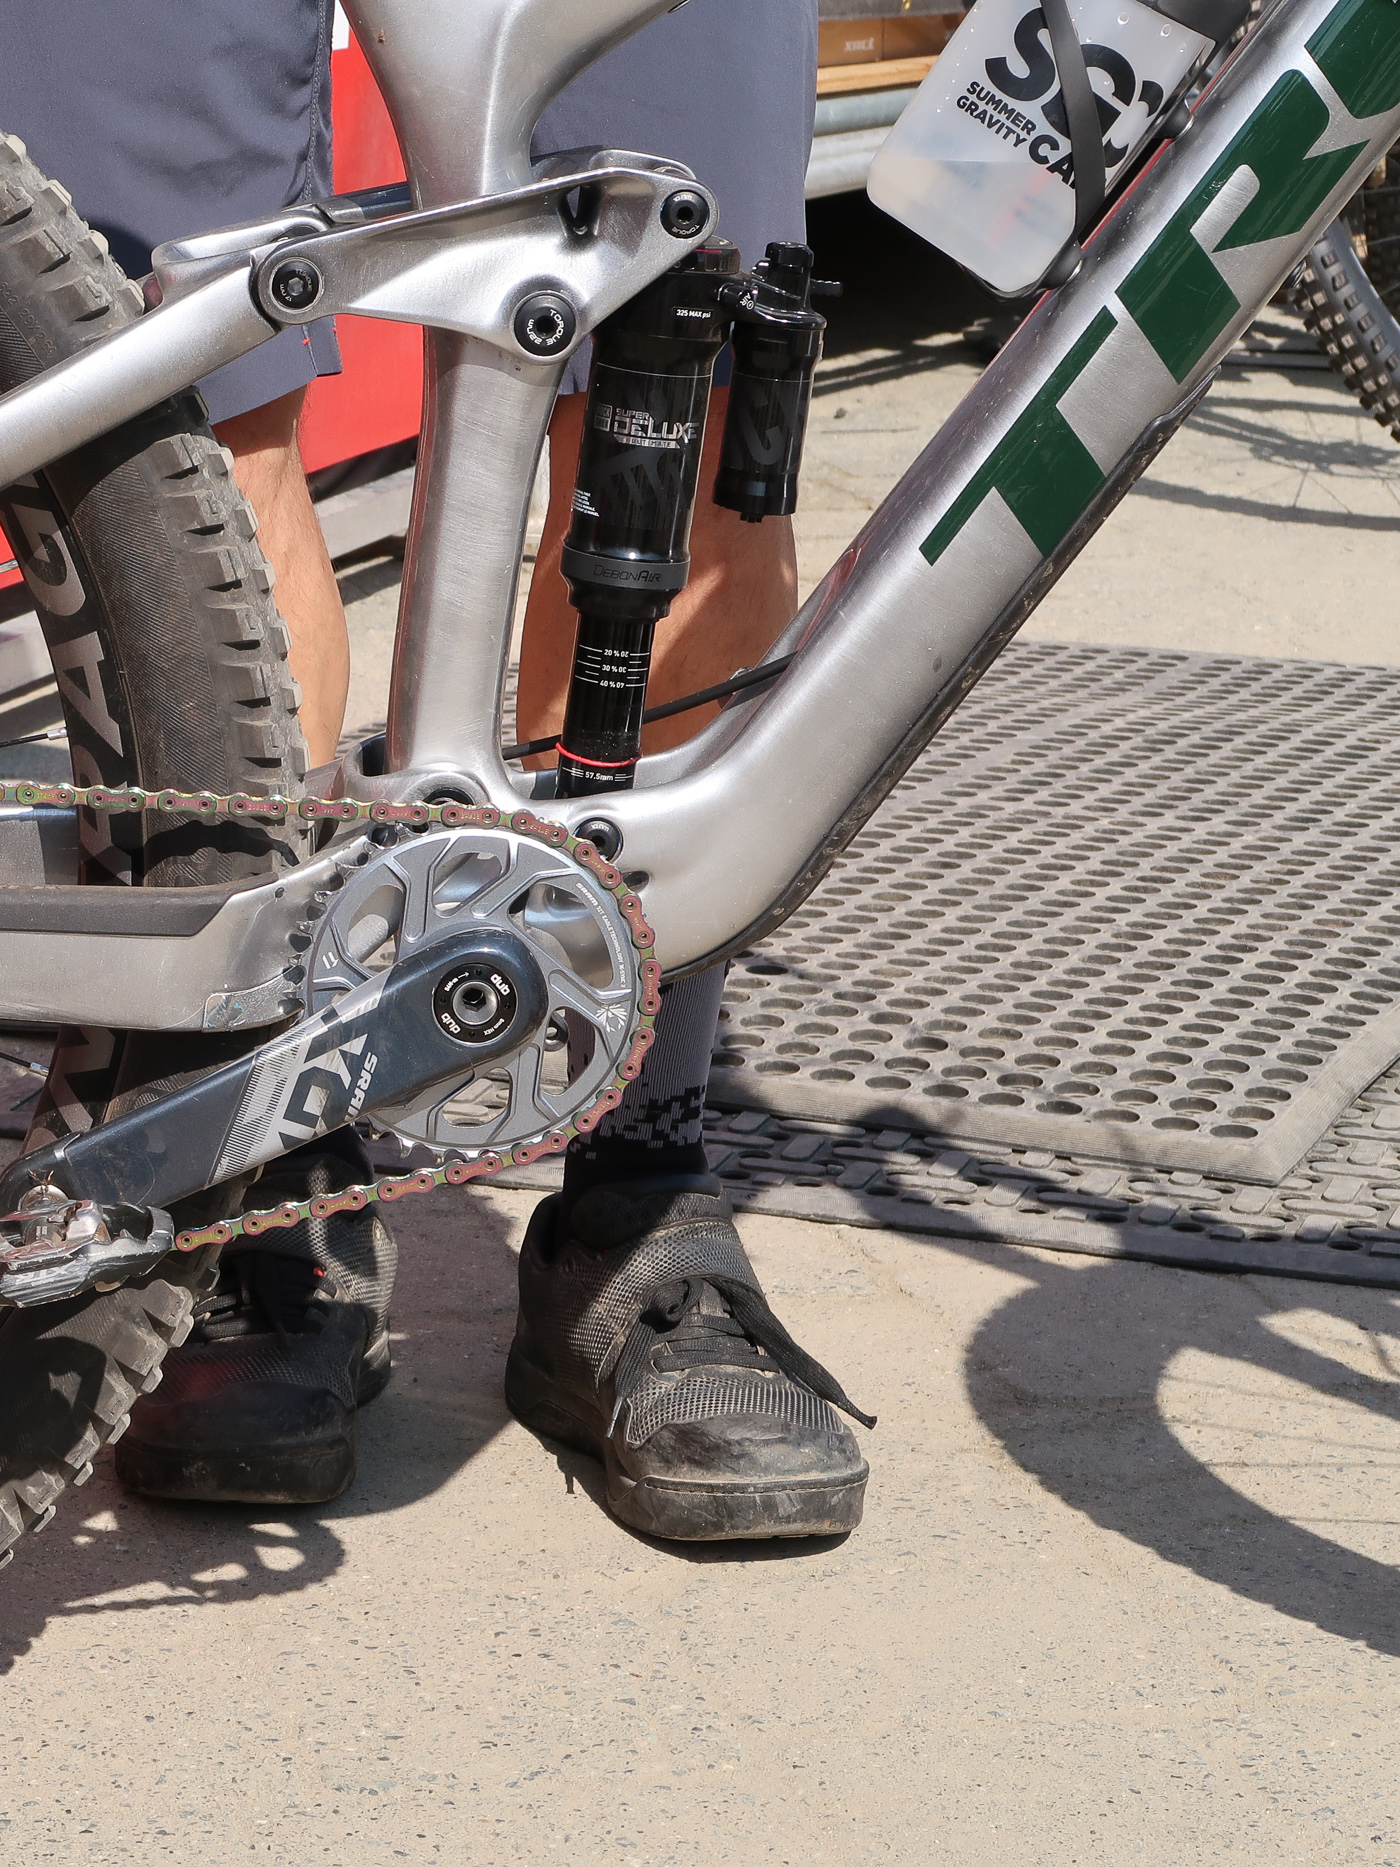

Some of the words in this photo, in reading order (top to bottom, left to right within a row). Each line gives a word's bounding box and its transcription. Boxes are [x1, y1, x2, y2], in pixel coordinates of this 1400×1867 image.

[956, 95, 1028, 148] GRAVITY
[966, 81, 1037, 136] SUMMER
[1028, 134, 1077, 190] CA
[546, 309, 564, 346] TORQUE
[613, 416, 699, 443] DELUXE
[585, 771, 614, 782] 57.5mm
[575, 882, 598, 906] SRAM
[602, 914, 613, 932] EAGLE
[490, 973, 511, 996] dub
[441, 1012, 461, 1034] dub
